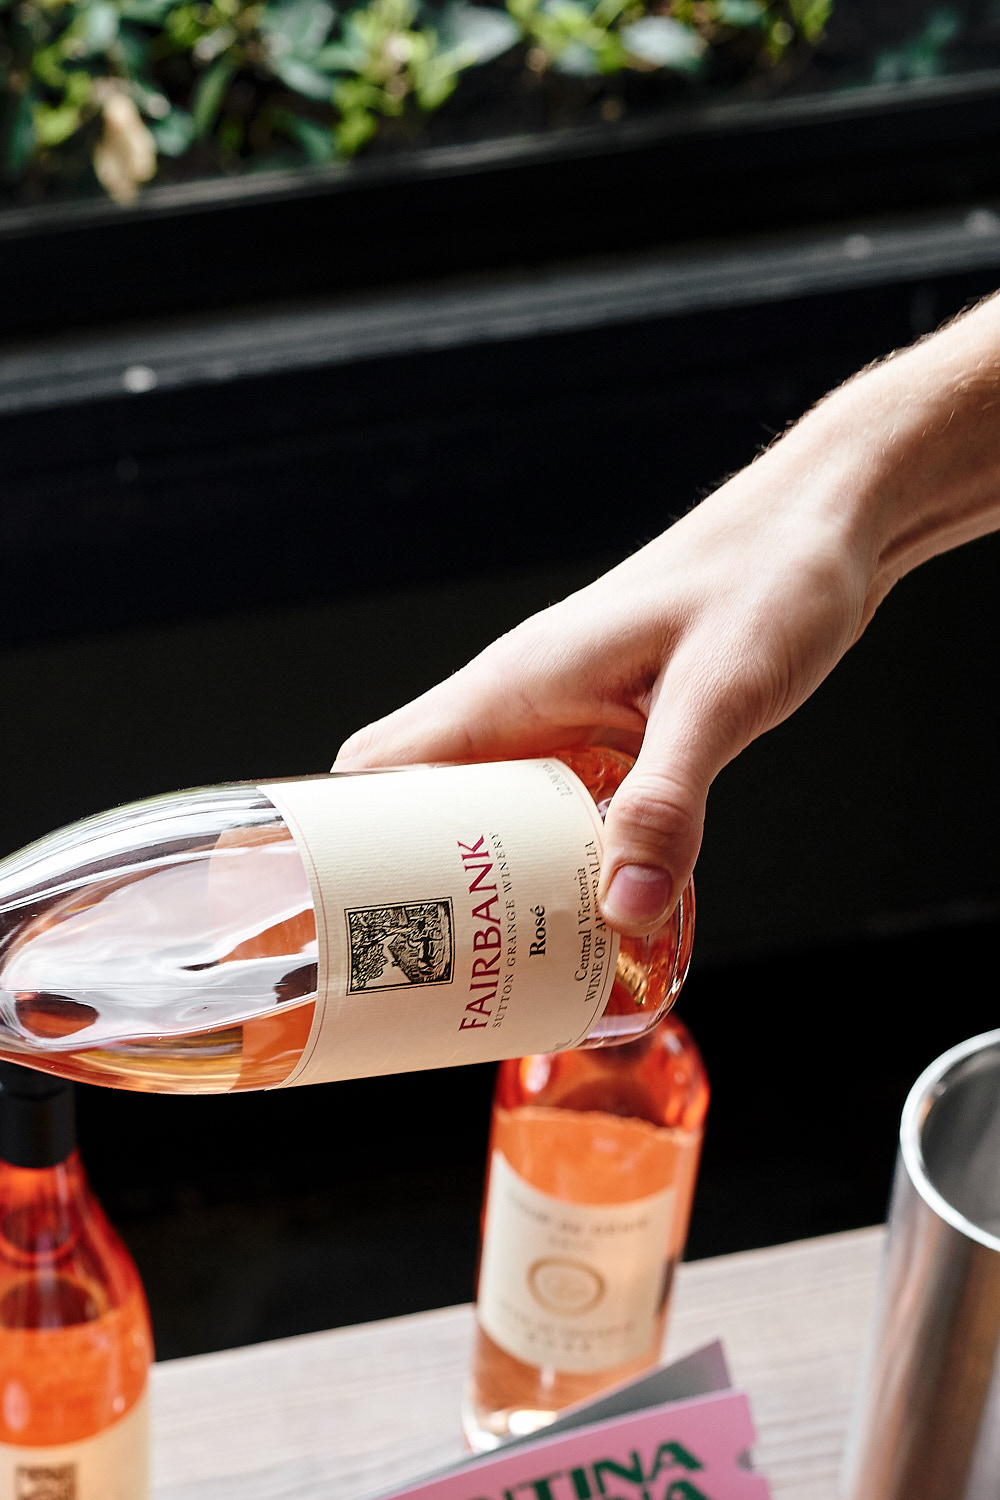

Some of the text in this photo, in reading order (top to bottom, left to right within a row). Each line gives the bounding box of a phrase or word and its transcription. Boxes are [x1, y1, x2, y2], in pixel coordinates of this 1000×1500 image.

[457, 834, 501, 1031] FAIRBANK
[490, 831, 517, 1029] SUTTON GRANGE WINERY
[529, 904, 546, 959] Rosé
[574, 867, 592, 982] Central Victoria
[584, 961, 604, 1003] WINE
[594, 936, 607, 959] OF
